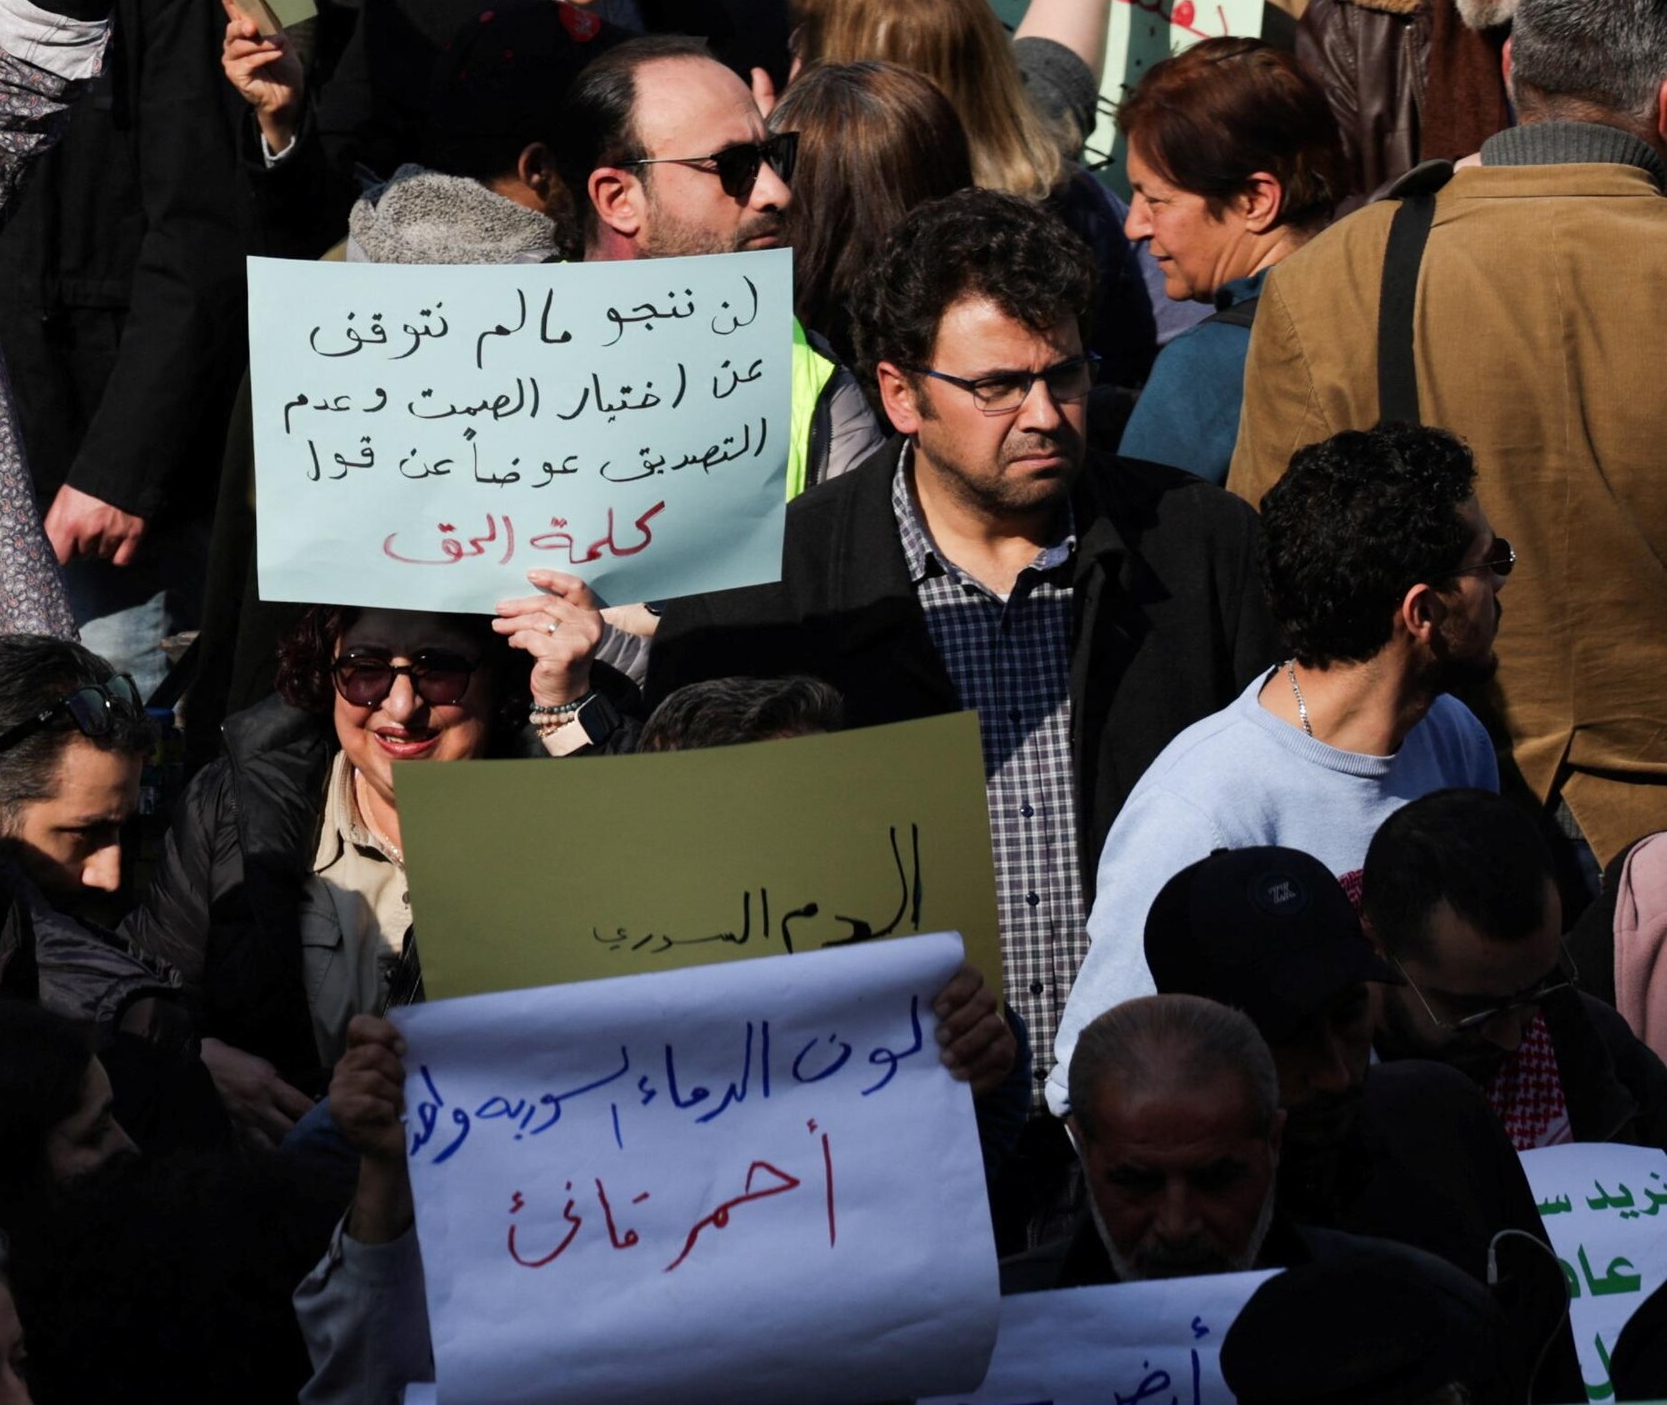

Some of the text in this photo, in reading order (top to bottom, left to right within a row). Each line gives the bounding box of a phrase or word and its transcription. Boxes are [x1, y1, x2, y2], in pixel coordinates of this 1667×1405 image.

[309, 302, 449, 360] نتوقف
[601, 287, 695, 346] ننجو
[710, 275, 759, 336] لن
[556, 362, 686, 424] اختيار
[712, 356, 763, 398] عن
[306, 435, 375, 482] قول
[399, 448, 455, 479] عن
[599, 417, 768, 483] التصديق
[383, 501, 666, 566] كلمة الحق
[780, 822, 922, 954] الدم
[639, 1019, 770, 1125] الدماء
[792, 993, 924, 1096] لون
[662, 1117, 835, 1272] أحمر
